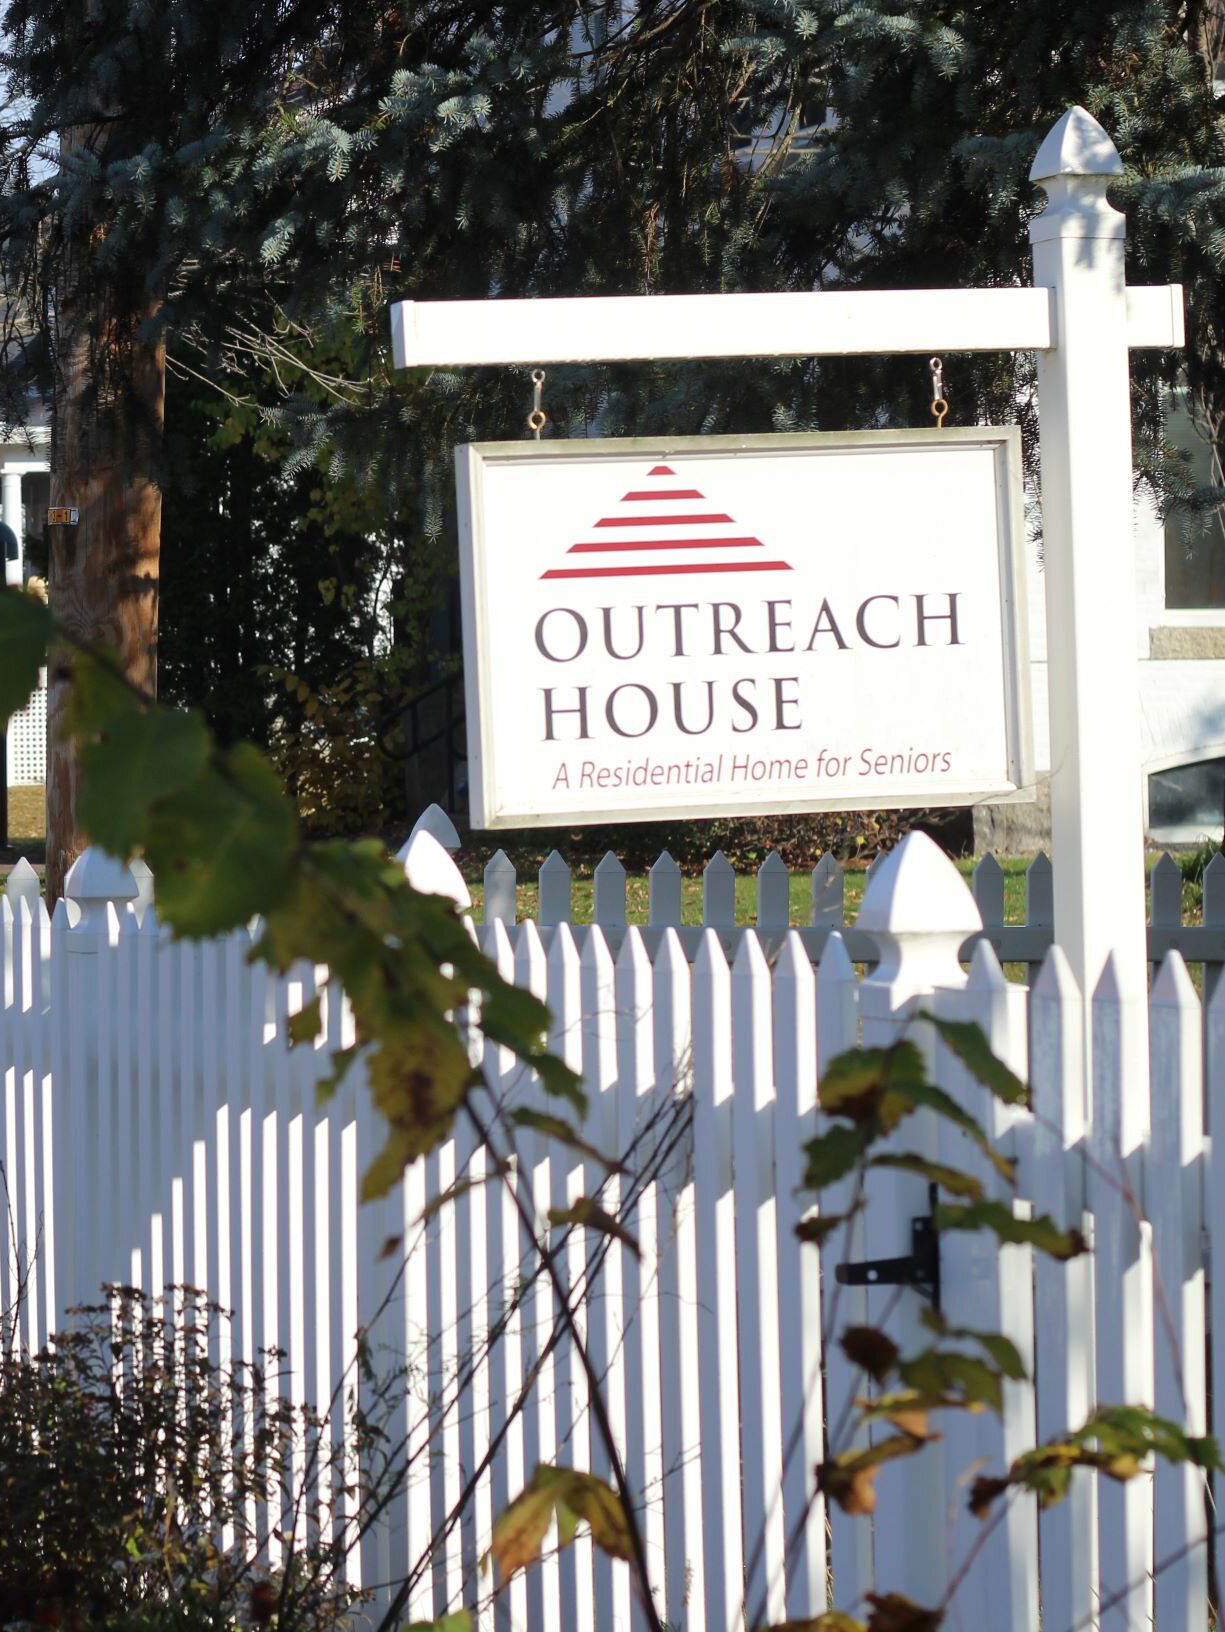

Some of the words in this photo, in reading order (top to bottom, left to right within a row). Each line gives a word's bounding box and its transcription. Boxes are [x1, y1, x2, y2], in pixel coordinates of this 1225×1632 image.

[534, 592, 964, 663] OUTREACH
[541, 676, 802, 741] HOUSE
[552, 762, 570, 790] A
[579, 754, 723, 788] Residential
[730, 754, 809, 782] Home
[816, 748, 852, 778] for
[858, 748, 952, 777] Seniors
